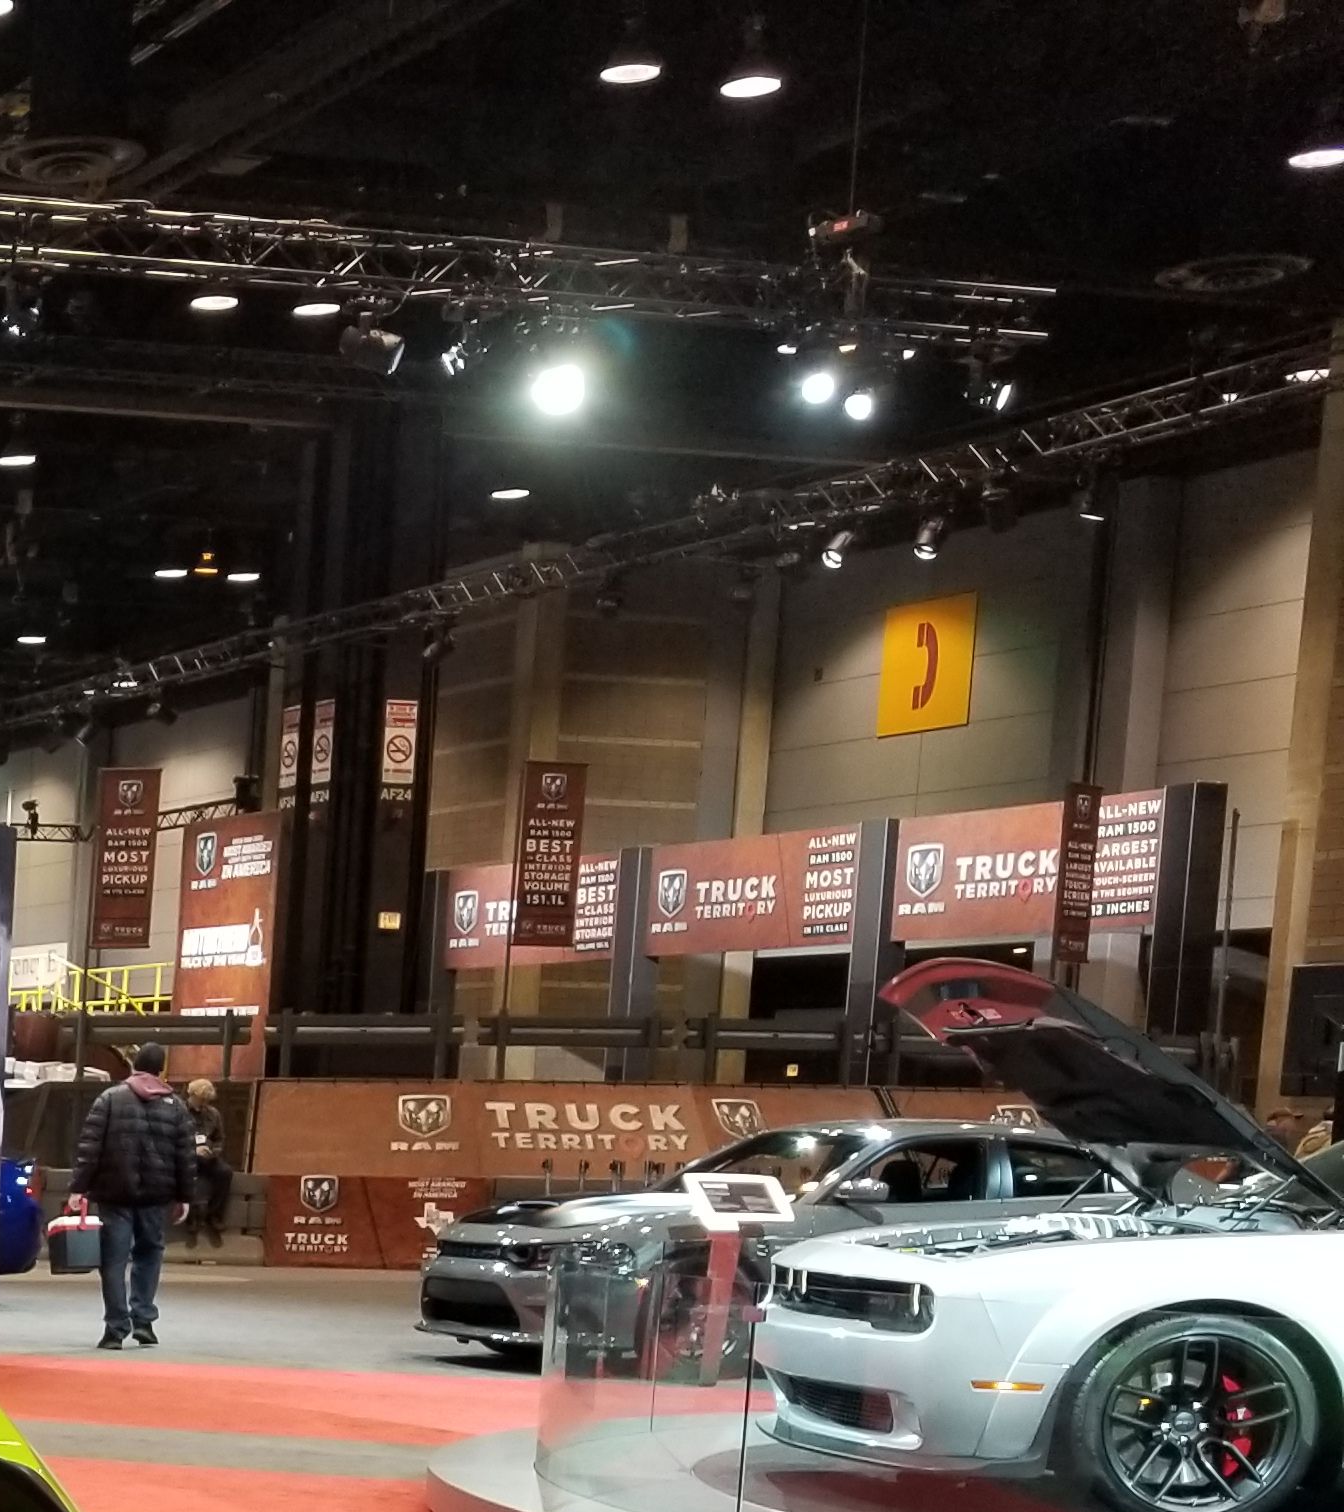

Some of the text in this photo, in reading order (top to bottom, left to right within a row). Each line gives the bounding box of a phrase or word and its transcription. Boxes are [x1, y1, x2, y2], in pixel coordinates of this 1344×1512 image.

[380, 788, 412, 800] AF24
[1098, 799, 1162, 820] ALL-NEW
[528, 818, 576, 828] ALL-NEW
[1097, 820, 1156, 838] RAM 1500
[106, 827, 151, 836] ALL-NEW
[526, 839, 574, 853] BEST
[808, 832, 857, 849] ALL-NEW
[103, 850, 150, 863] MOST
[535, 853, 573, 862] CLASS
[809, 853, 829, 865] RAM
[524, 863, 572, 871] INTERIOR
[579, 860, 618, 873] ALL-NEW
[955, 848, 1059, 882] TRUCK
[1094, 856, 1156, 873] AVAILABLE
[102, 874, 148, 885] PICKUP
[524, 872, 571, 881] STORAGE
[805, 867, 854, 889] MOST
[524, 881, 570, 892] VOLUME
[696, 875, 777, 903] TRUCK
[1100, 889, 1116, 898] THE
[1116, 885, 1154, 897] SEGMENT
[577, 884, 617, 905] BEST
[804, 889, 853, 903] LUXURIOUS
[584, 902, 615, 915] CLASS
[803, 902, 852, 920] PICKUP
[898, 901, 945, 916] RAM
[1106, 900, 1150, 915] INCHES
[575, 915, 614, 928] INTERIOR
[651, 921, 688, 934] RAM
[575, 926, 613, 940] STORAGE
[485, 1102, 686, 1131] TRUCK
[390, 1141, 460, 1152] RAM
[491, 1132, 689, 1151] TERRITORY
[293, 1215, 342, 1225] RAM
[284, 1232, 348, 1245] TRUCK
